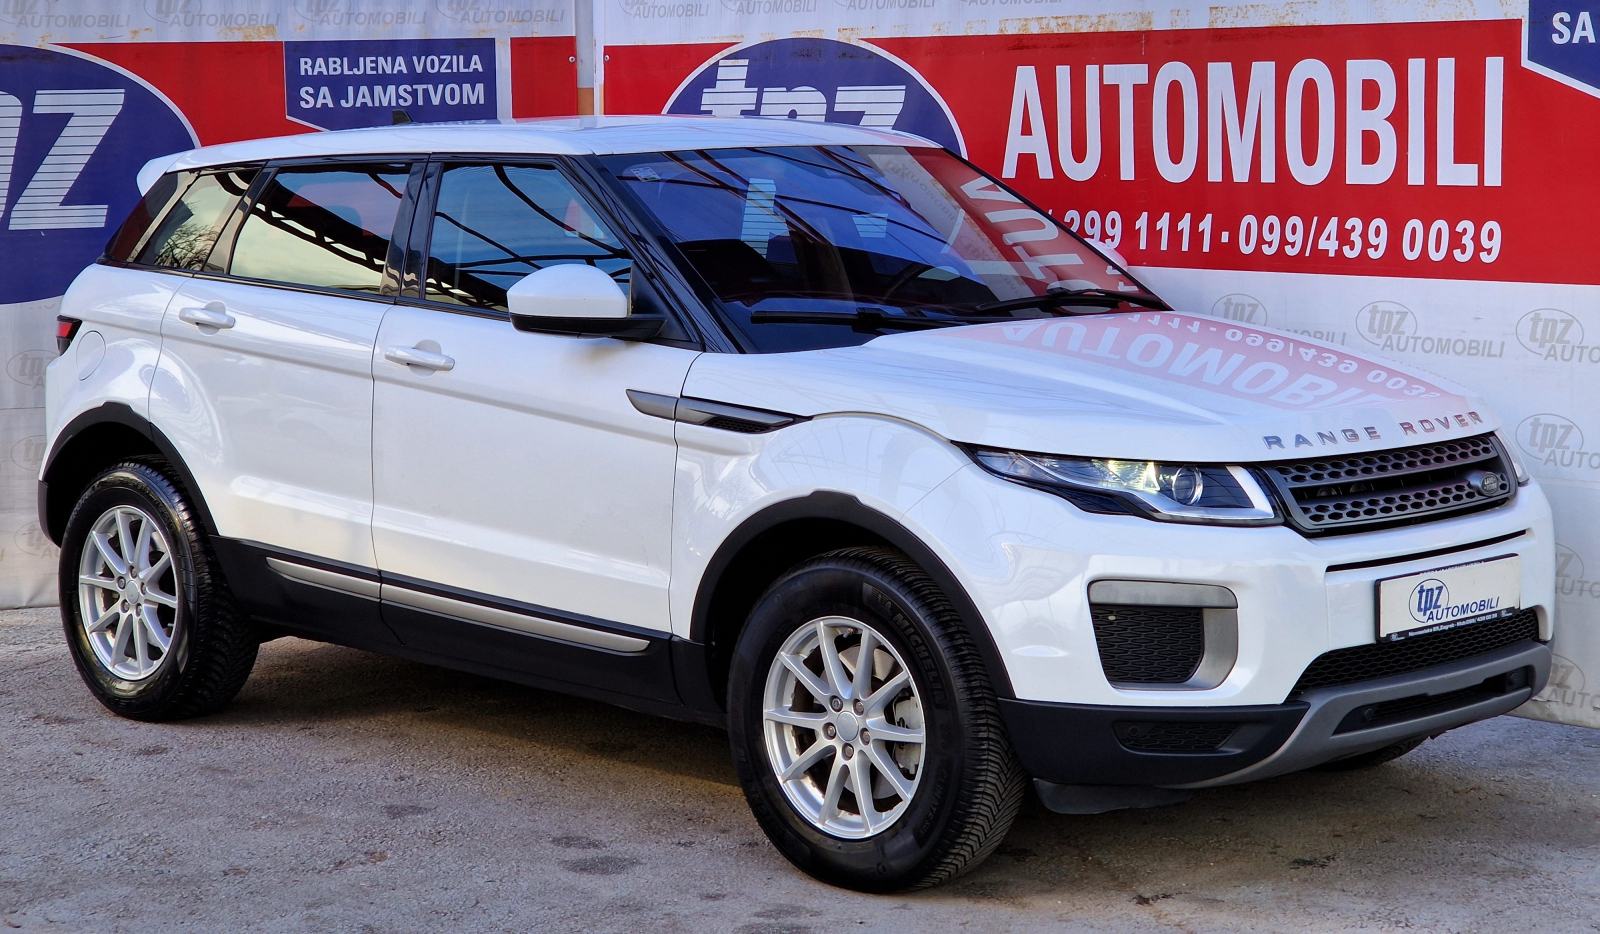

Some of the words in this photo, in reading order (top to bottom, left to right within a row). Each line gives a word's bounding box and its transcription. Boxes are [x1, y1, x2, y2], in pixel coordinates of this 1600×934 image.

[169, 13, 280, 27] AUTOMOBILI
[320, 11, 427, 25] AUTOMOBILI
[460, 9, 565, 23] AUTOMOBILI
[633, 4, 709, 18] AUTOMOBILI
[736, 0, 817, 15] AUTOMOBILI
[16, 14, 130, 28] AUTOMOBILI
[1551, 11, 1596, 45] SA
[299, 56, 408, 76] RABLJENA
[412, 54, 484, 74] VOZILA
[299, 86, 334, 109] SA
[340, 83, 485, 108] JAMSTVOM
[1002, 57, 1504, 187] AUTOMOBILI
[1402, 219, 1502, 264] 0039
[1367, 304, 1409, 339] tpz
[1528, 312, 1574, 348] tpz
[1380, 334, 1505, 359] AUTOMOBILI
[1263, 426, 1381, 449] RANGE
[1399, 411, 1483, 436] ROVER
[1529, 417, 1574, 453] tpz
[1417, 585, 1443, 616] tpz
[1426, 597, 1500, 623] AUTOMOBILI
